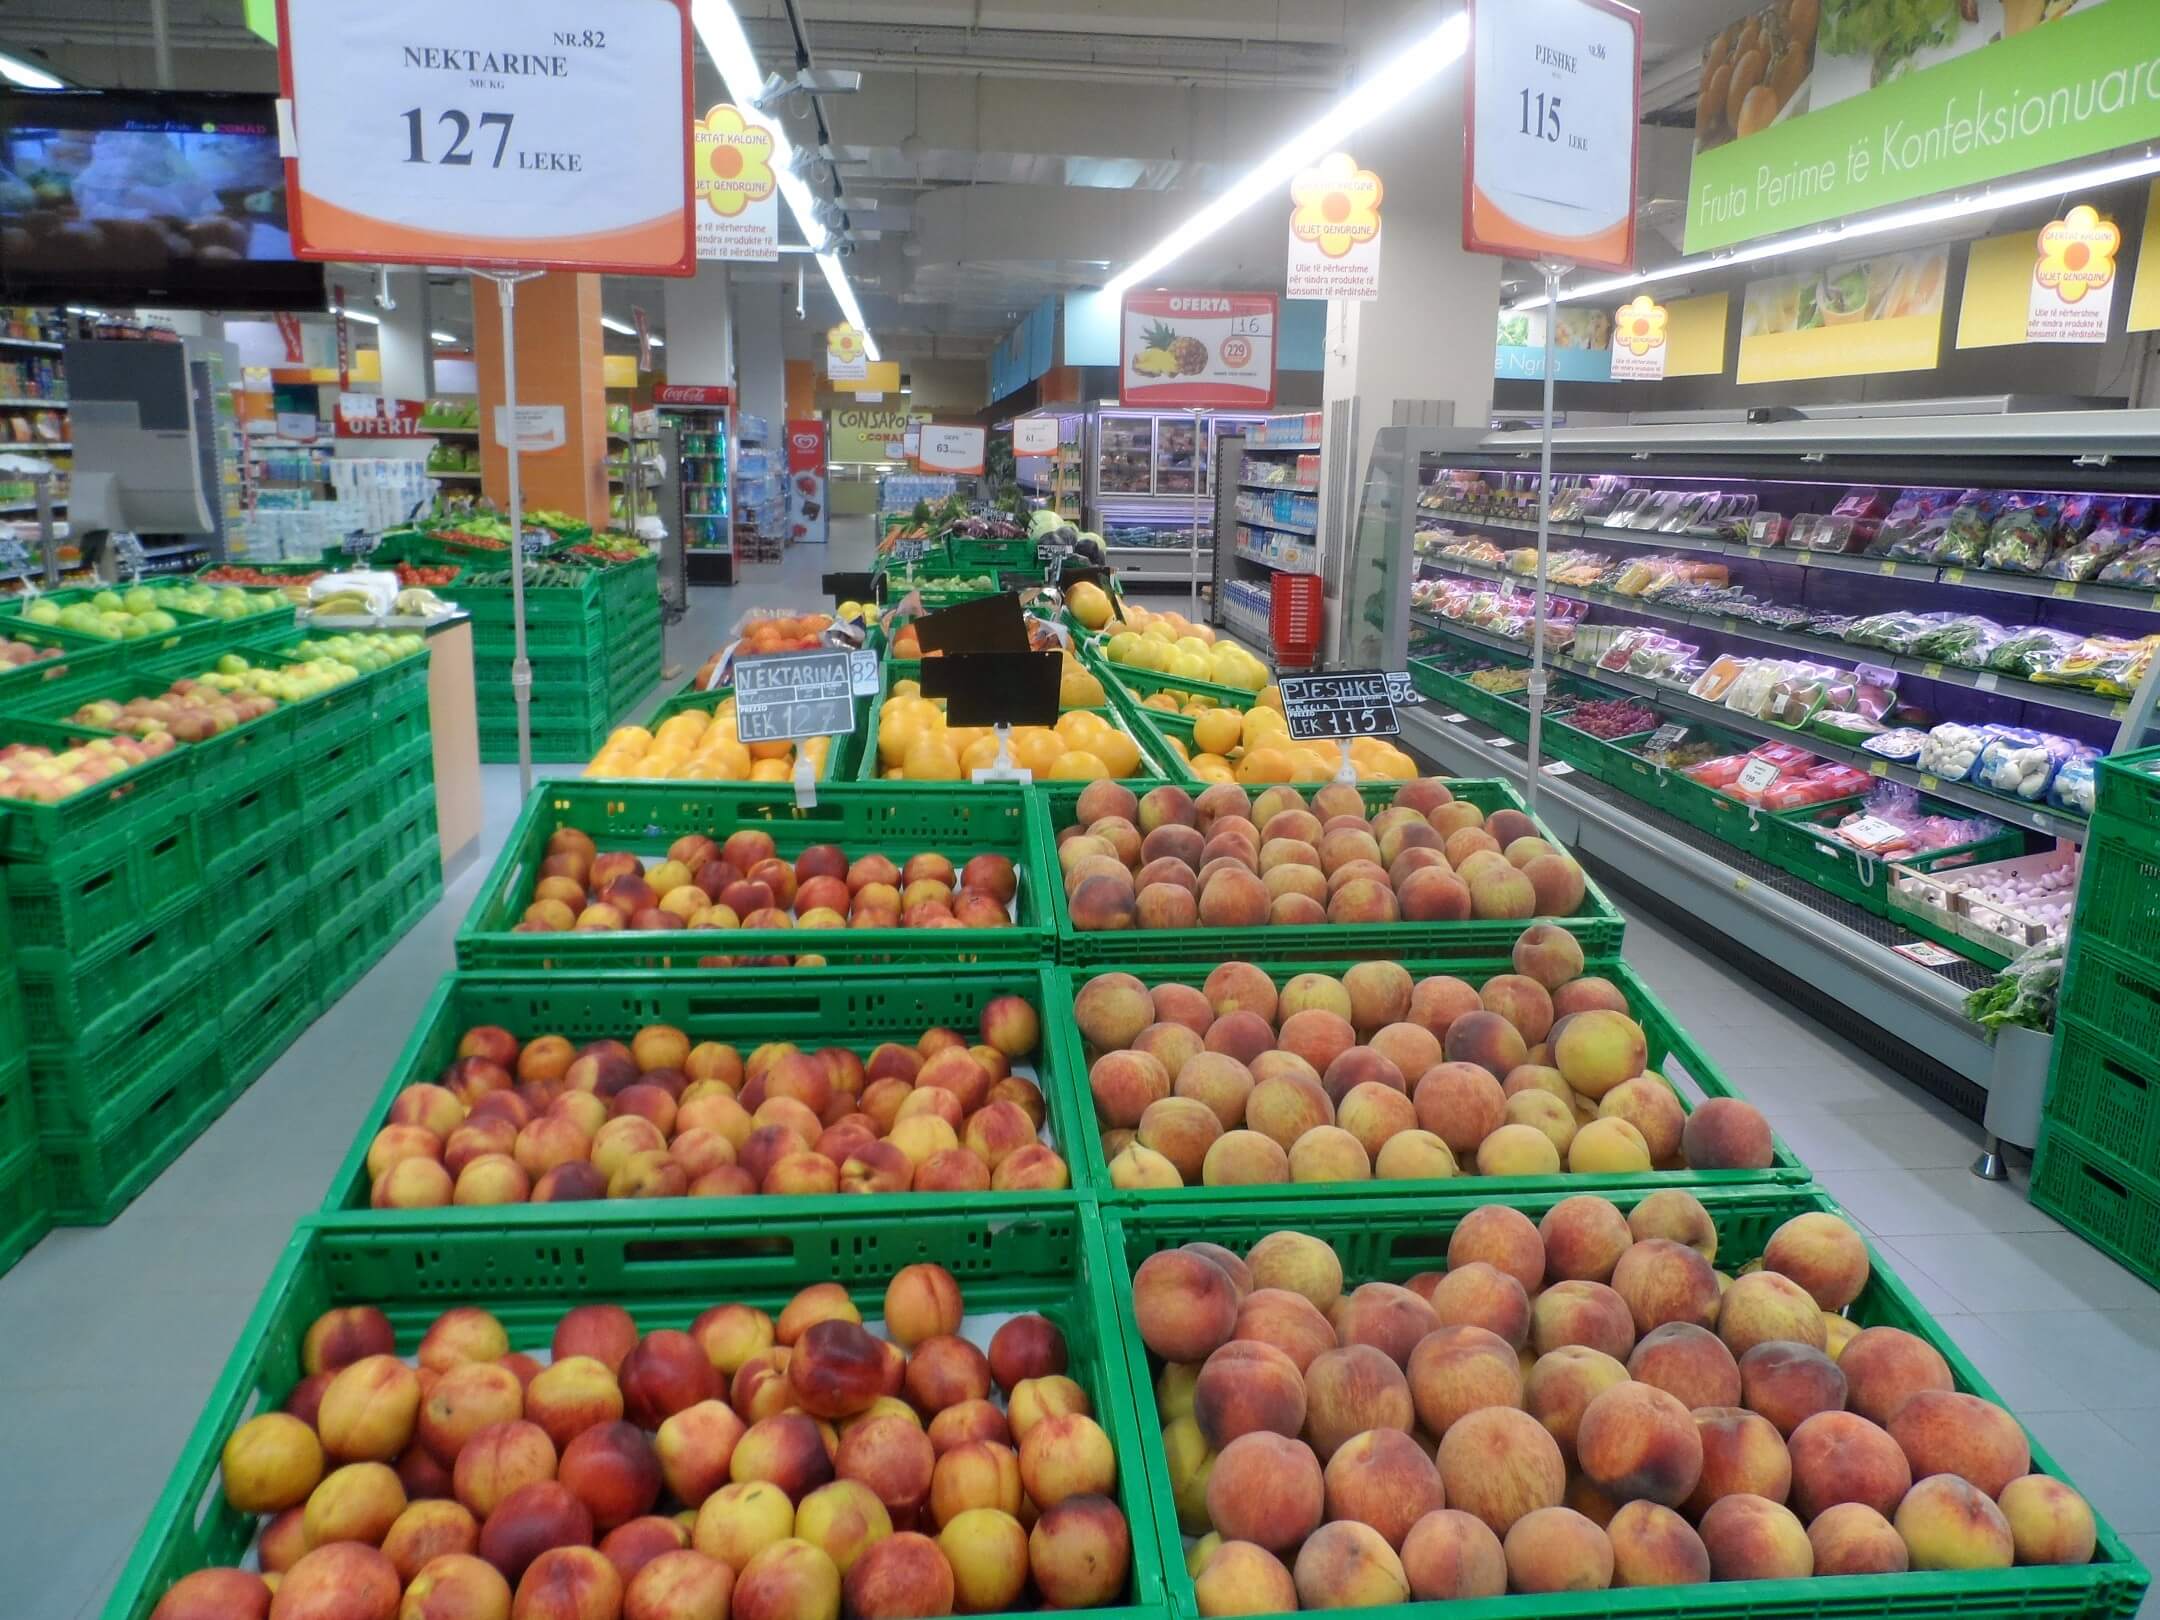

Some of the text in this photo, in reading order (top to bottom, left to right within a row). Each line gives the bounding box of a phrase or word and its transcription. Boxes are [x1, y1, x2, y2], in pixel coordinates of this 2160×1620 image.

[553, 29, 606, 48] NR.82
[402, 46, 568, 78] NEKTARINE
[1535, 44, 1577, 74] PJESHKE
[1520, 88, 1589, 151] 115 LEKE
[400, 107, 583, 172] 127 LEKE
[695, 133, 768, 145] ERTAT KALOJNE
[696, 180, 710, 190] JET
[1699, 184, 1747, 226] Fruta
[1756, 161, 1835, 209] Perime
[1847, 138, 1871, 184] të
[1169, 297, 1231, 312] OFERTA
[1238, 317, 1260, 334] 16
[1227, 344, 1246, 357] 229
[1509, 353, 1561, 376] Ngra
[839, 411, 922, 429] CONSAPO
[936, 443, 949, 453] 63
[738, 664, 845, 690] NEKTARINA
[851, 662, 877, 682] 82
[1283, 679, 1385, 701] PJESHKE
[1389, 682, 1417, 702] 86
[742, 703, 836, 738] LEK 127
[1292, 718, 1324, 735] LEK
[1329, 709, 1377, 733] 115
